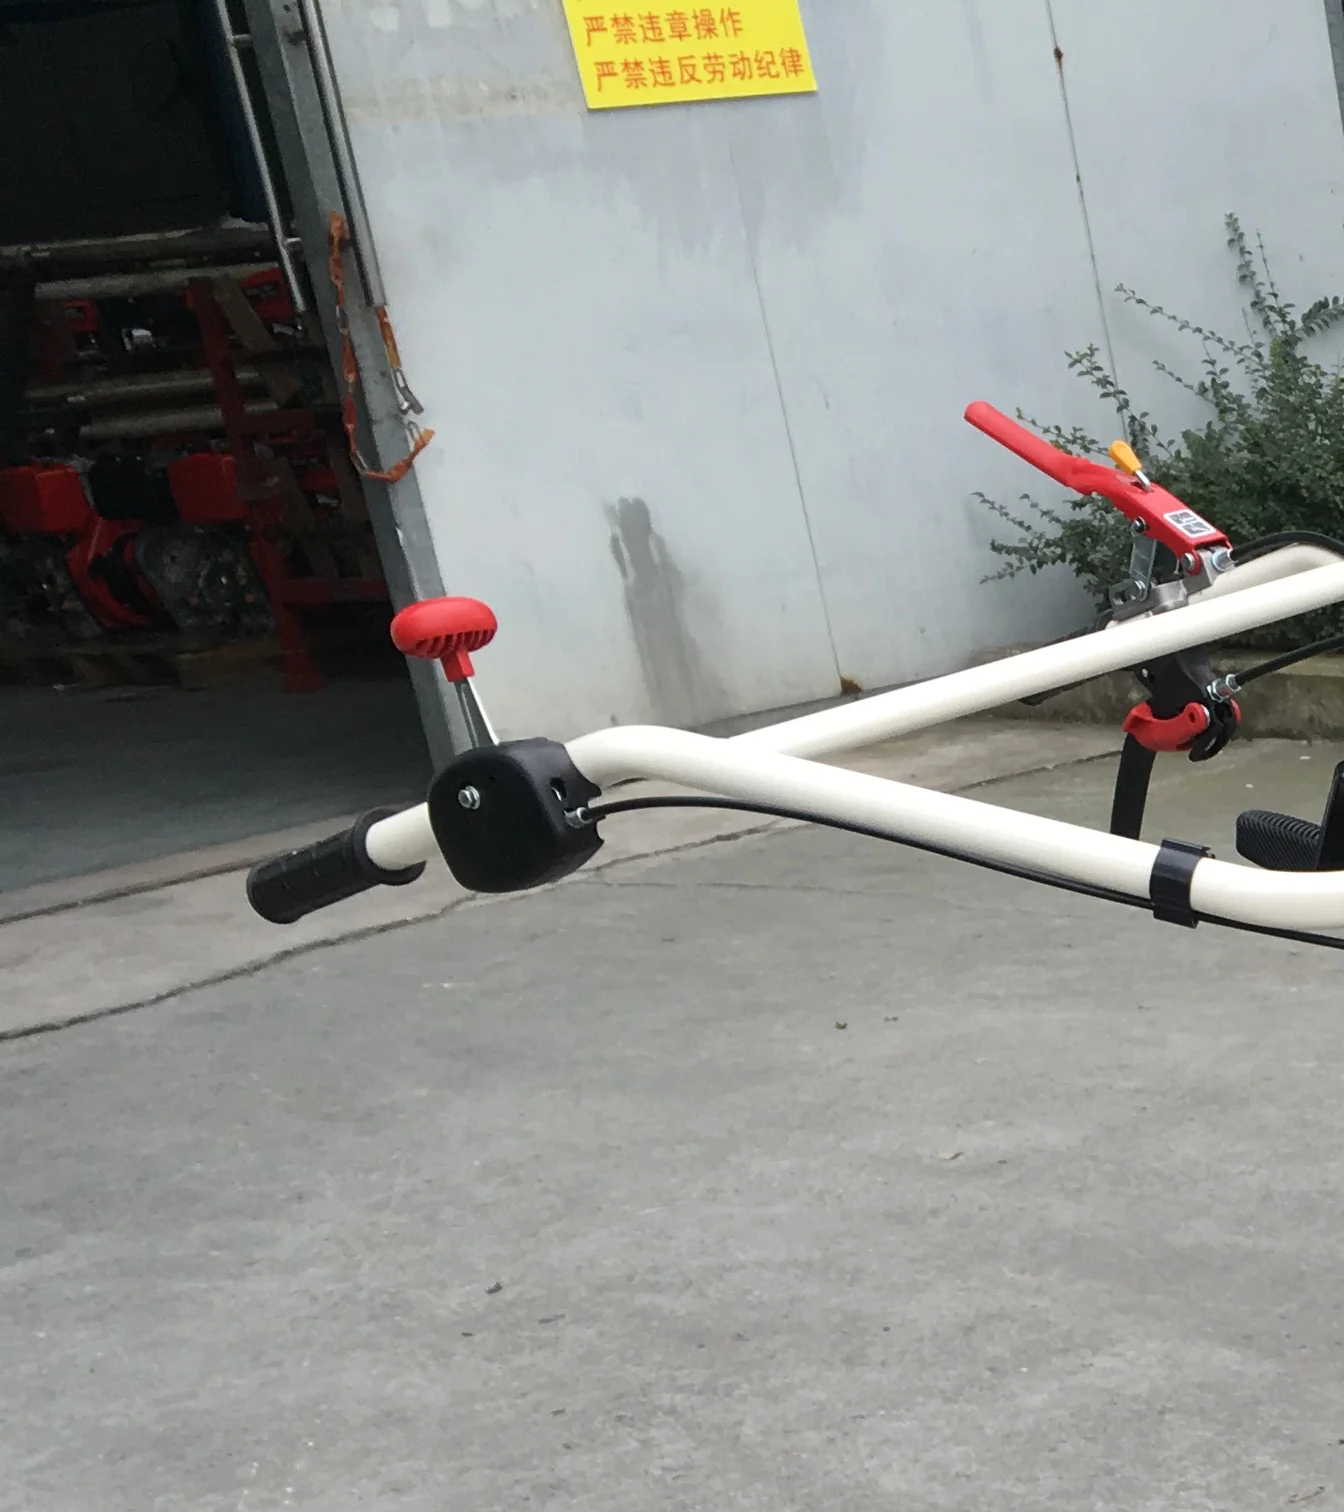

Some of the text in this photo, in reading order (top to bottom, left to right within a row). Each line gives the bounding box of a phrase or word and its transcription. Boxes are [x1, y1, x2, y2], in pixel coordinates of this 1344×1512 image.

[582, 6, 744, 47] 严禁违章操作
[593, 47, 805, 92] 严禁违反劳动纪律
